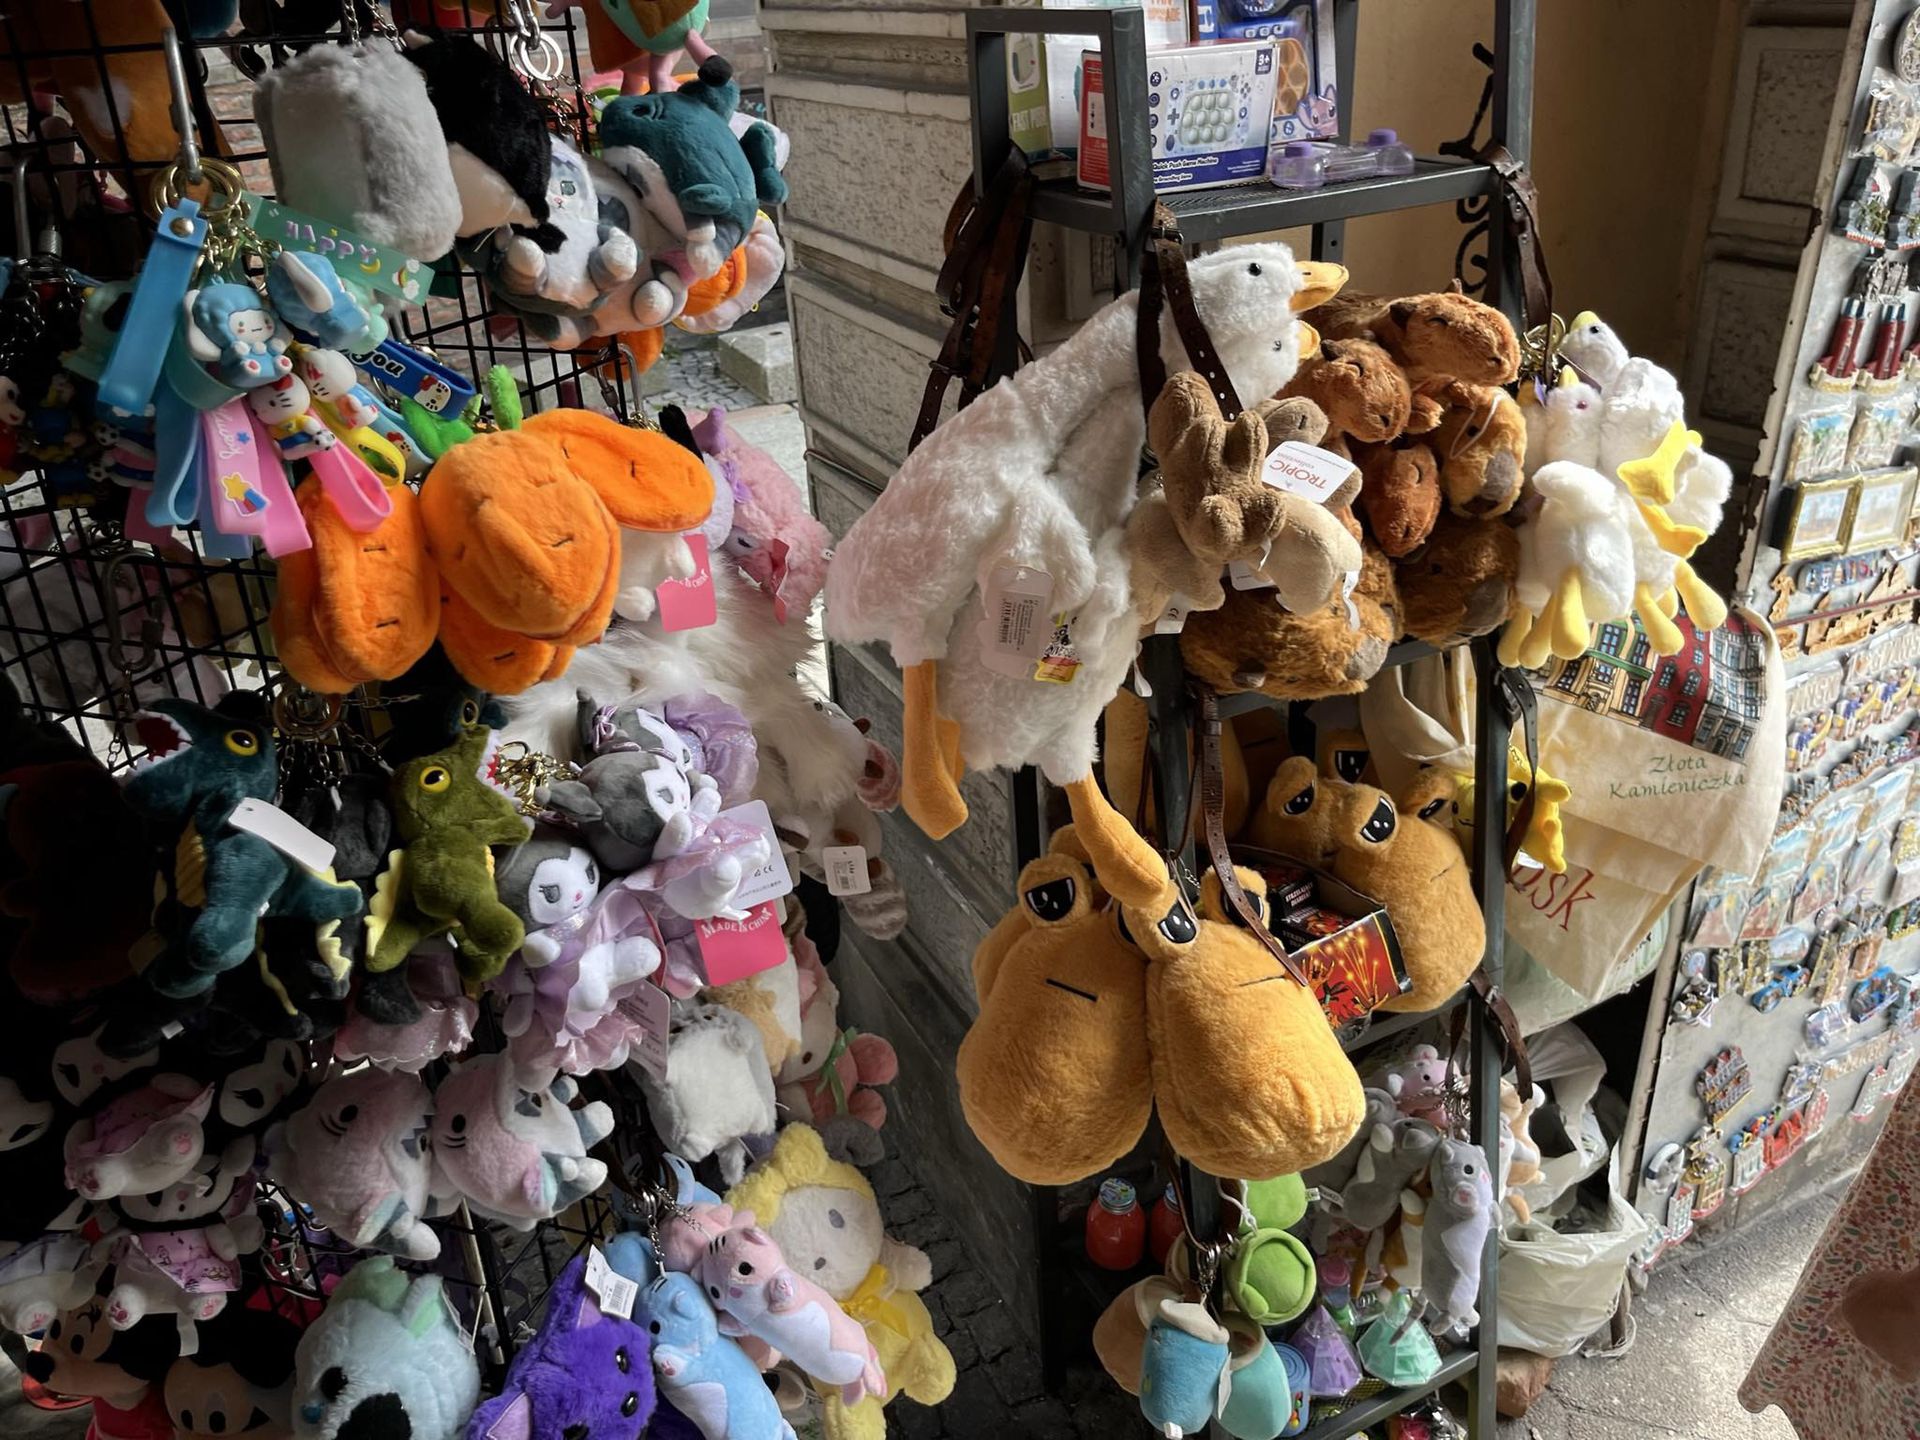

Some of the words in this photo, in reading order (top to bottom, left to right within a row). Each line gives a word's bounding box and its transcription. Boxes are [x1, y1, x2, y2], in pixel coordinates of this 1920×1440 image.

[1258, 54, 1270, 66] 3+
[285, 220, 376, 263] HAPPY
[1269, 460, 1327, 489] TROPIC
[1649, 753, 1707, 773] Złota
[1609, 772, 1745, 799] Kamieniczka
[700, 922, 738, 939] MADE
